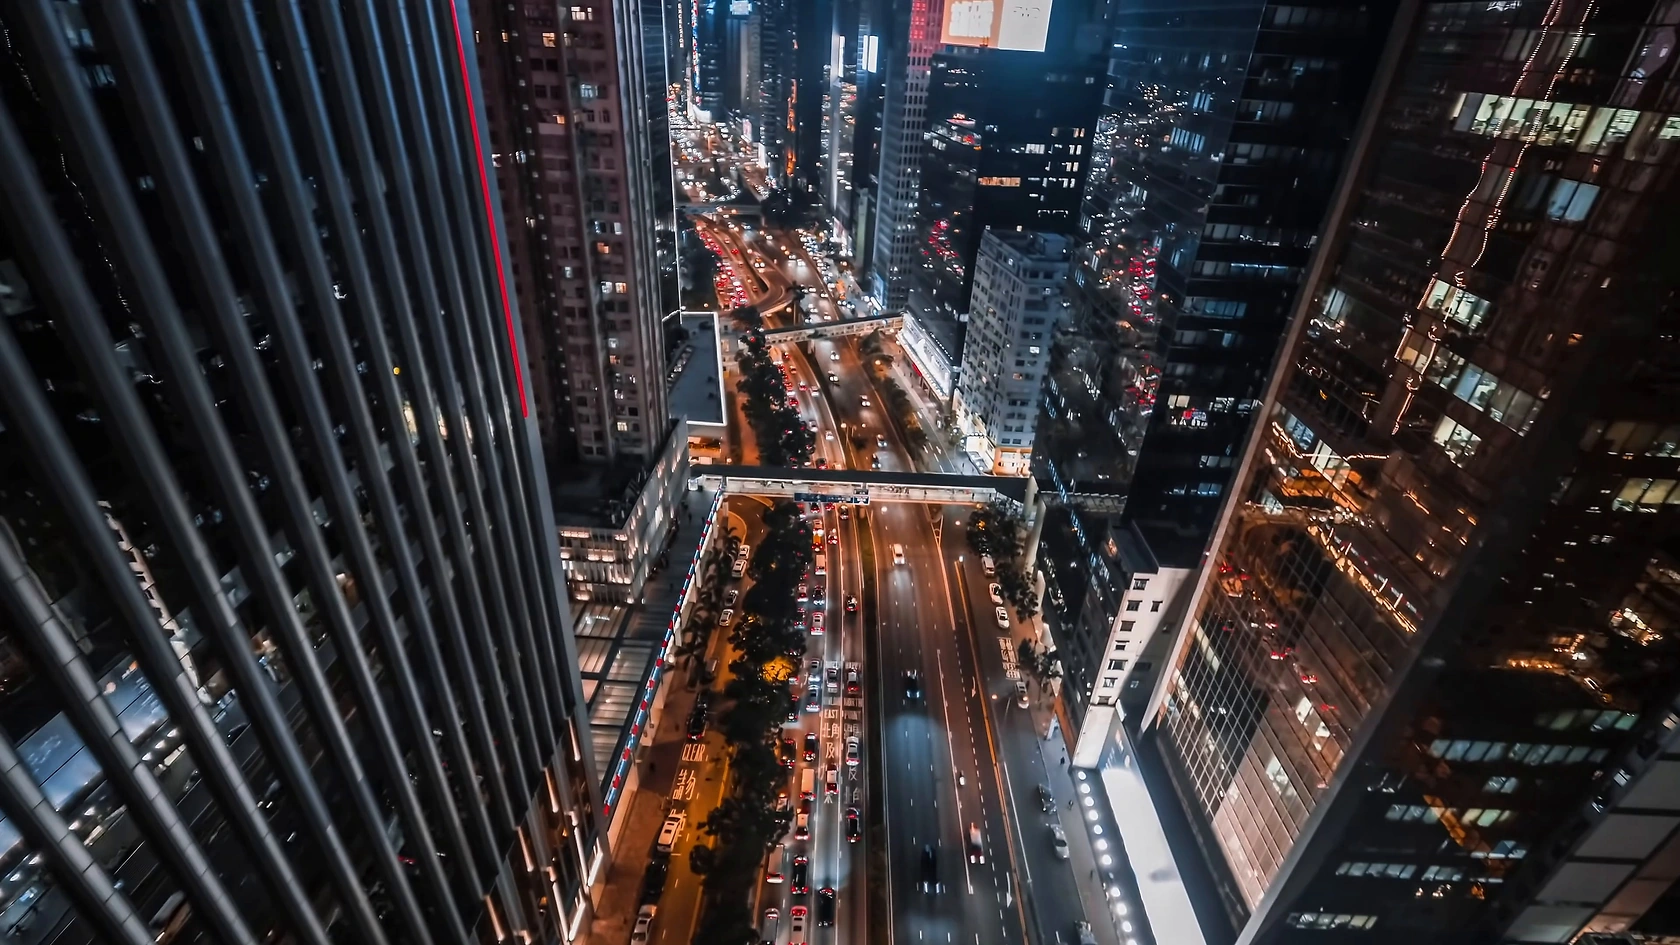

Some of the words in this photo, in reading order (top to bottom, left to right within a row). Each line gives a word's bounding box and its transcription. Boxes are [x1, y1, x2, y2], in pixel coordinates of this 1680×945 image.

[824, 709, 839, 719] EAST
[821, 722, 840, 739] 北角
[682, 744, 706, 761] CLEAR
[825, 742, 835, 759] 及
